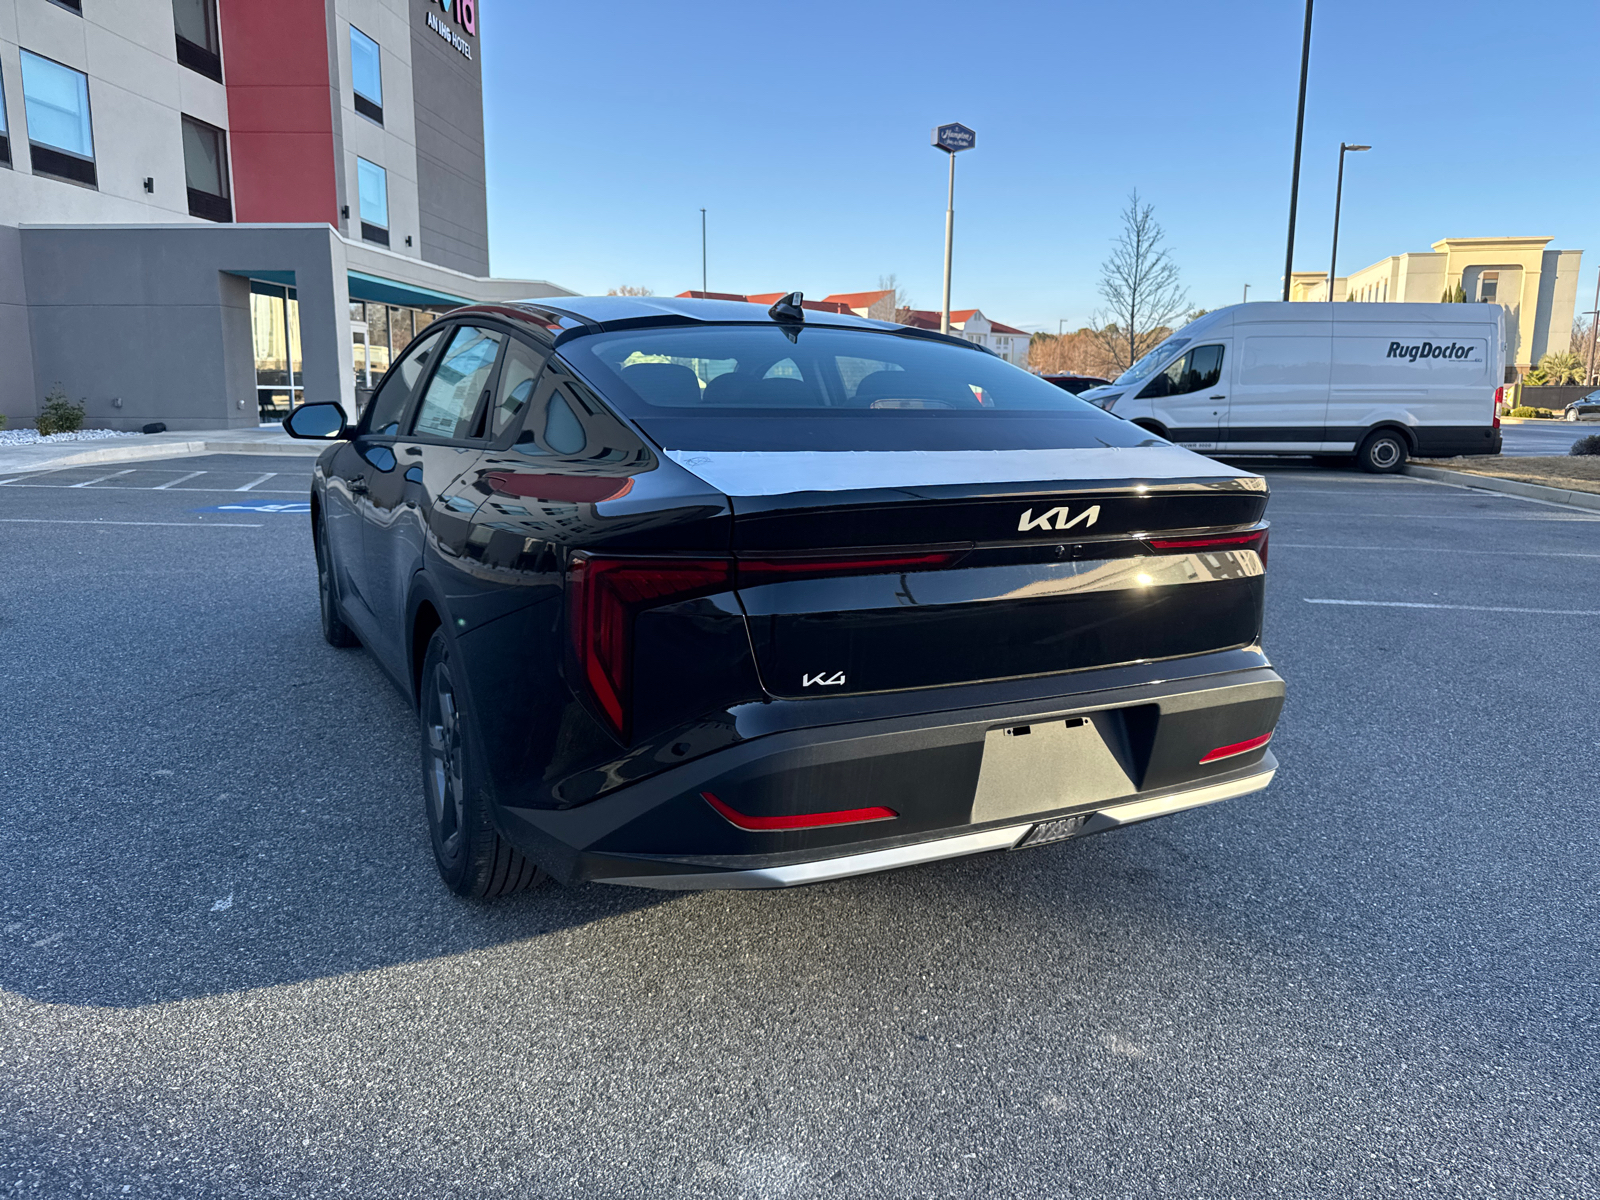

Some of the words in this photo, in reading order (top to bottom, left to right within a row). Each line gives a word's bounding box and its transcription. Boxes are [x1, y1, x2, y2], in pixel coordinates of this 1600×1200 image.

[427, 11, 438, 32] AN
[438, 19, 451, 43] IHG
[451, 31, 472, 60] HOTEL
[1386, 342, 1475, 363] RugDoctor
[1017, 505, 1101, 532] KIA
[802, 670, 846, 687] K4
